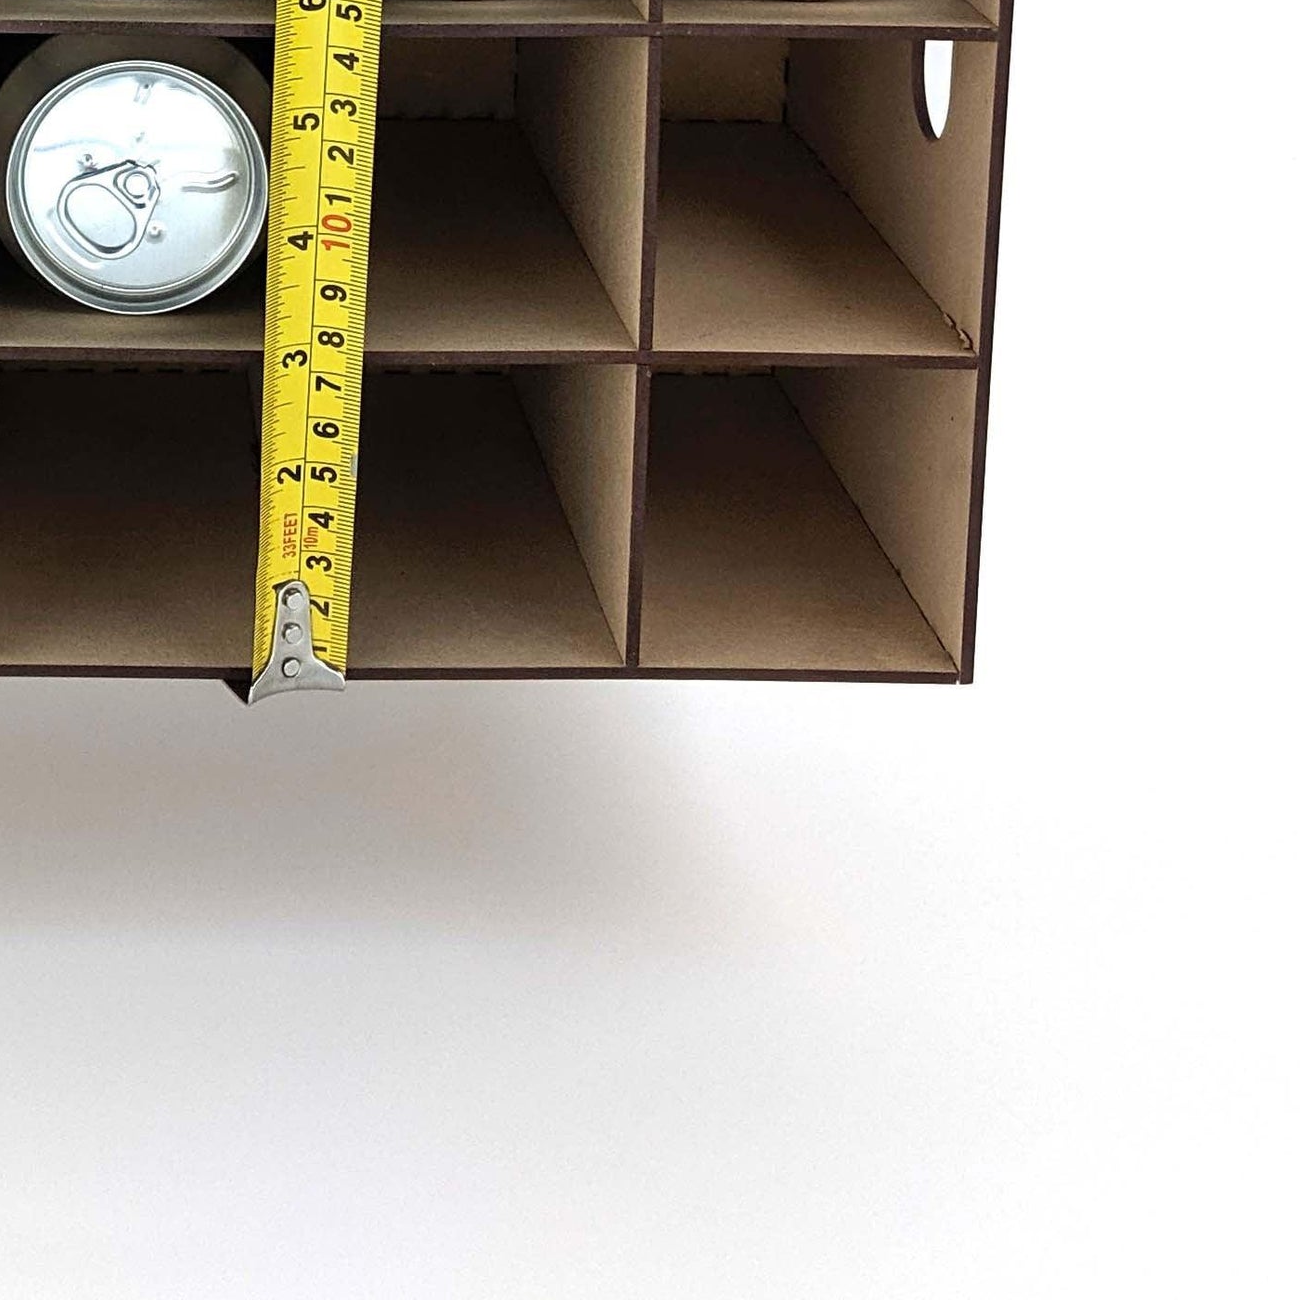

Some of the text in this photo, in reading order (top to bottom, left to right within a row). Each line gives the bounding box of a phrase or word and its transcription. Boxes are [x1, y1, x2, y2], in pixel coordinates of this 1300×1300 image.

[336, 3, 362, 22] 5
[333, 52, 359, 71] 4
[330, 99, 357, 117] 3
[293, 113, 320, 131] 5
[327, 145, 354, 165] 2
[324, 193, 352, 206] 1
[287, 231, 313, 251] 4
[321, 214, 353, 251] 10
[320, 284, 347, 302] 9
[317, 330, 345, 348] 8
[282, 350, 308, 368] 3
[315, 376, 341, 391] 7
[313, 422, 340, 439] 6
[277, 464, 301, 484] 2
[310, 466, 337, 483] 5
[308, 511, 334, 530] 4
[283, 512, 297, 558] 33FEET
[303, 526, 319, 549] 10m
[306, 555, 332, 572] 3
[310, 600, 329, 617] 2
